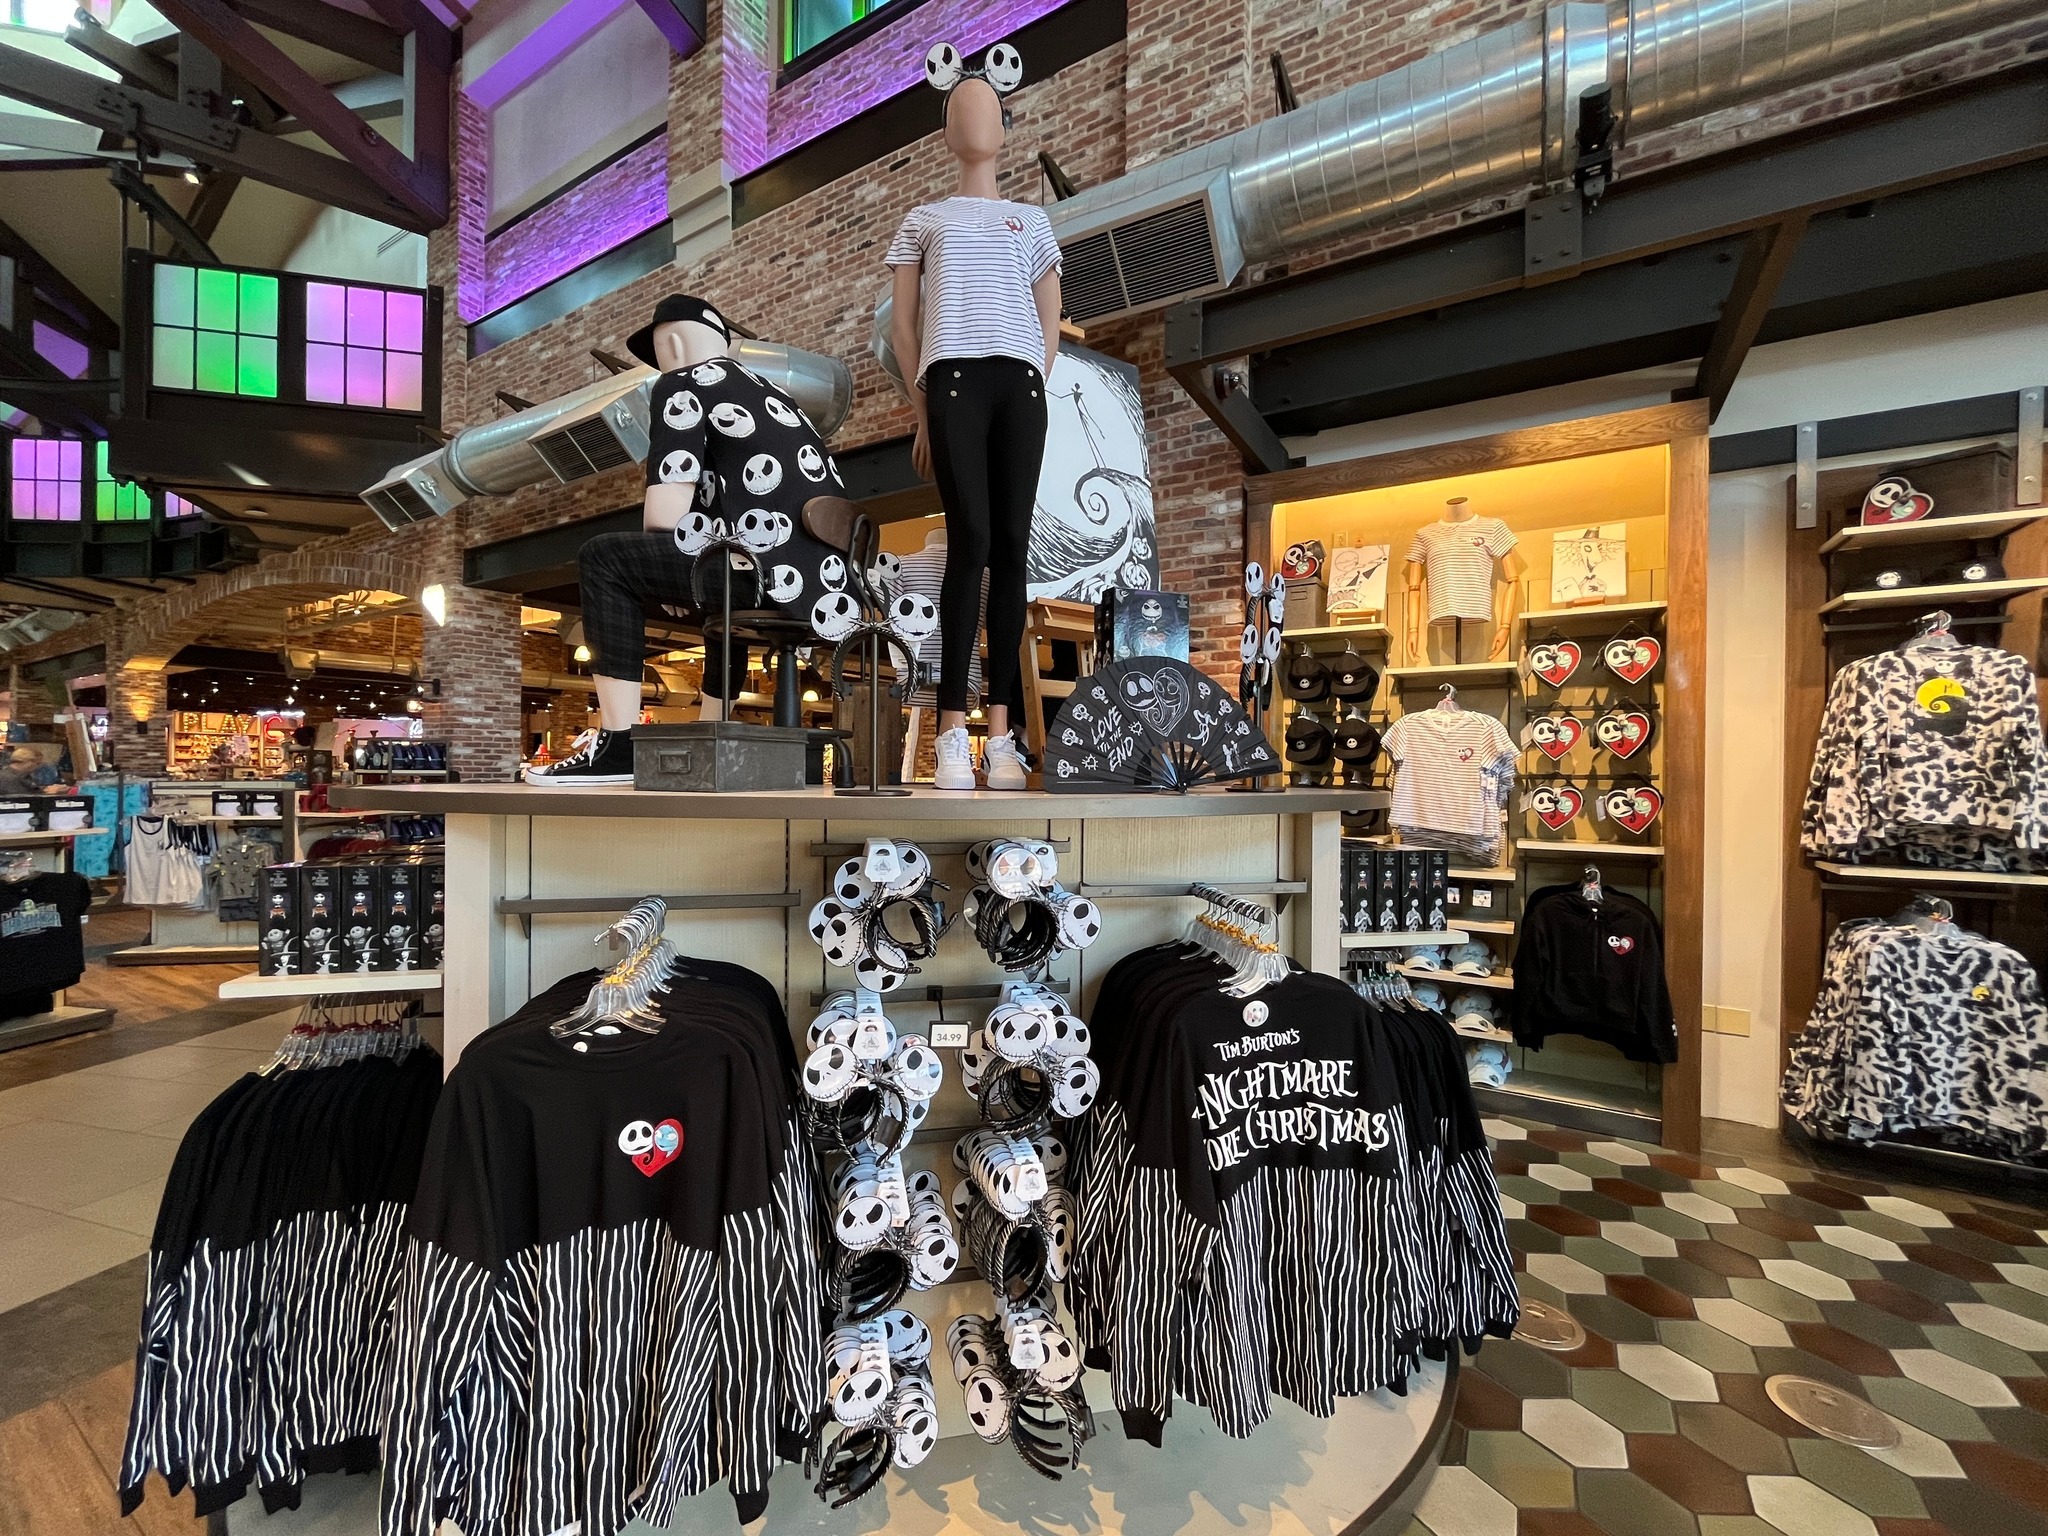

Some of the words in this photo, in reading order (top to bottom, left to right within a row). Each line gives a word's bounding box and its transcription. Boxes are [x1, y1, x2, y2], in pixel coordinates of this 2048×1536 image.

[183, 712, 251, 734] PLAY
[1091, 705, 1122, 745] LOVE
[1107, 736, 1133, 772] END
[936, 1033, 962, 1042] 34.99
[1213, 1041, 1240, 1062] TIM
[1198, 1059, 1358, 1130] NIGHTMARE
[1203, 1126, 1249, 1171] ORE
[1245, 1101, 1390, 1153] CHRISTMAS
